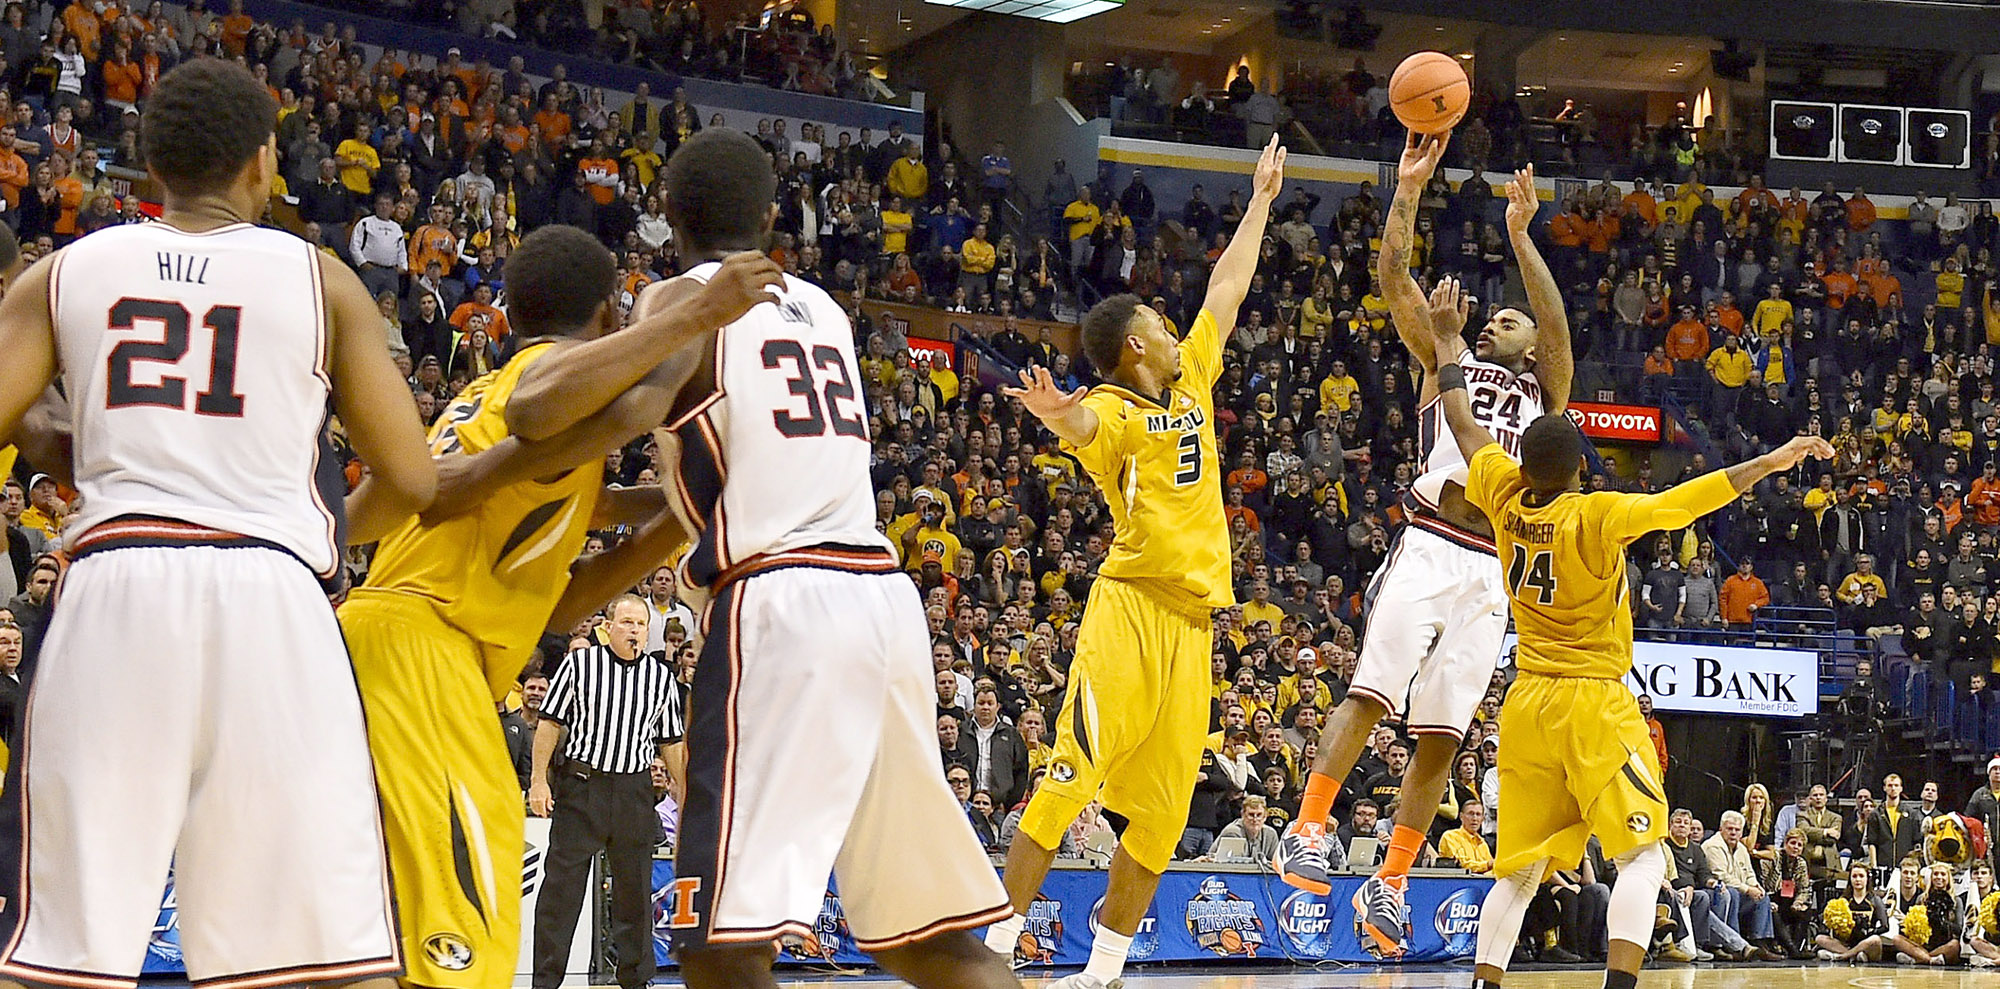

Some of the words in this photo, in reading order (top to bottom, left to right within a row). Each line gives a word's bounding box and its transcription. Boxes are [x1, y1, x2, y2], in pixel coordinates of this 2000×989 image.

[157, 252, 209, 284] HILL
[106, 297, 245, 418] 21
[760, 339, 871, 442] 32
[1471, 387, 1522, 428] 24
[1587, 412, 1657, 431] TOYOTA
[1175, 432, 1202, 487] 3
[1507, 542, 1557, 605] 14
[1740, 701, 1775, 712] Member
[1777, 703, 1799, 713] FDIC
[1372, 786, 1401, 796] MIZZ
[1206, 880, 1225, 888] BUD
[1293, 901, 1327, 918] BUD
[1450, 902, 1479, 918] BUD
[1198, 915, 1255, 933] RIGHTS
[1289, 918, 1333, 934] LIGHT
[1444, 919, 1480, 934] LIGHT
